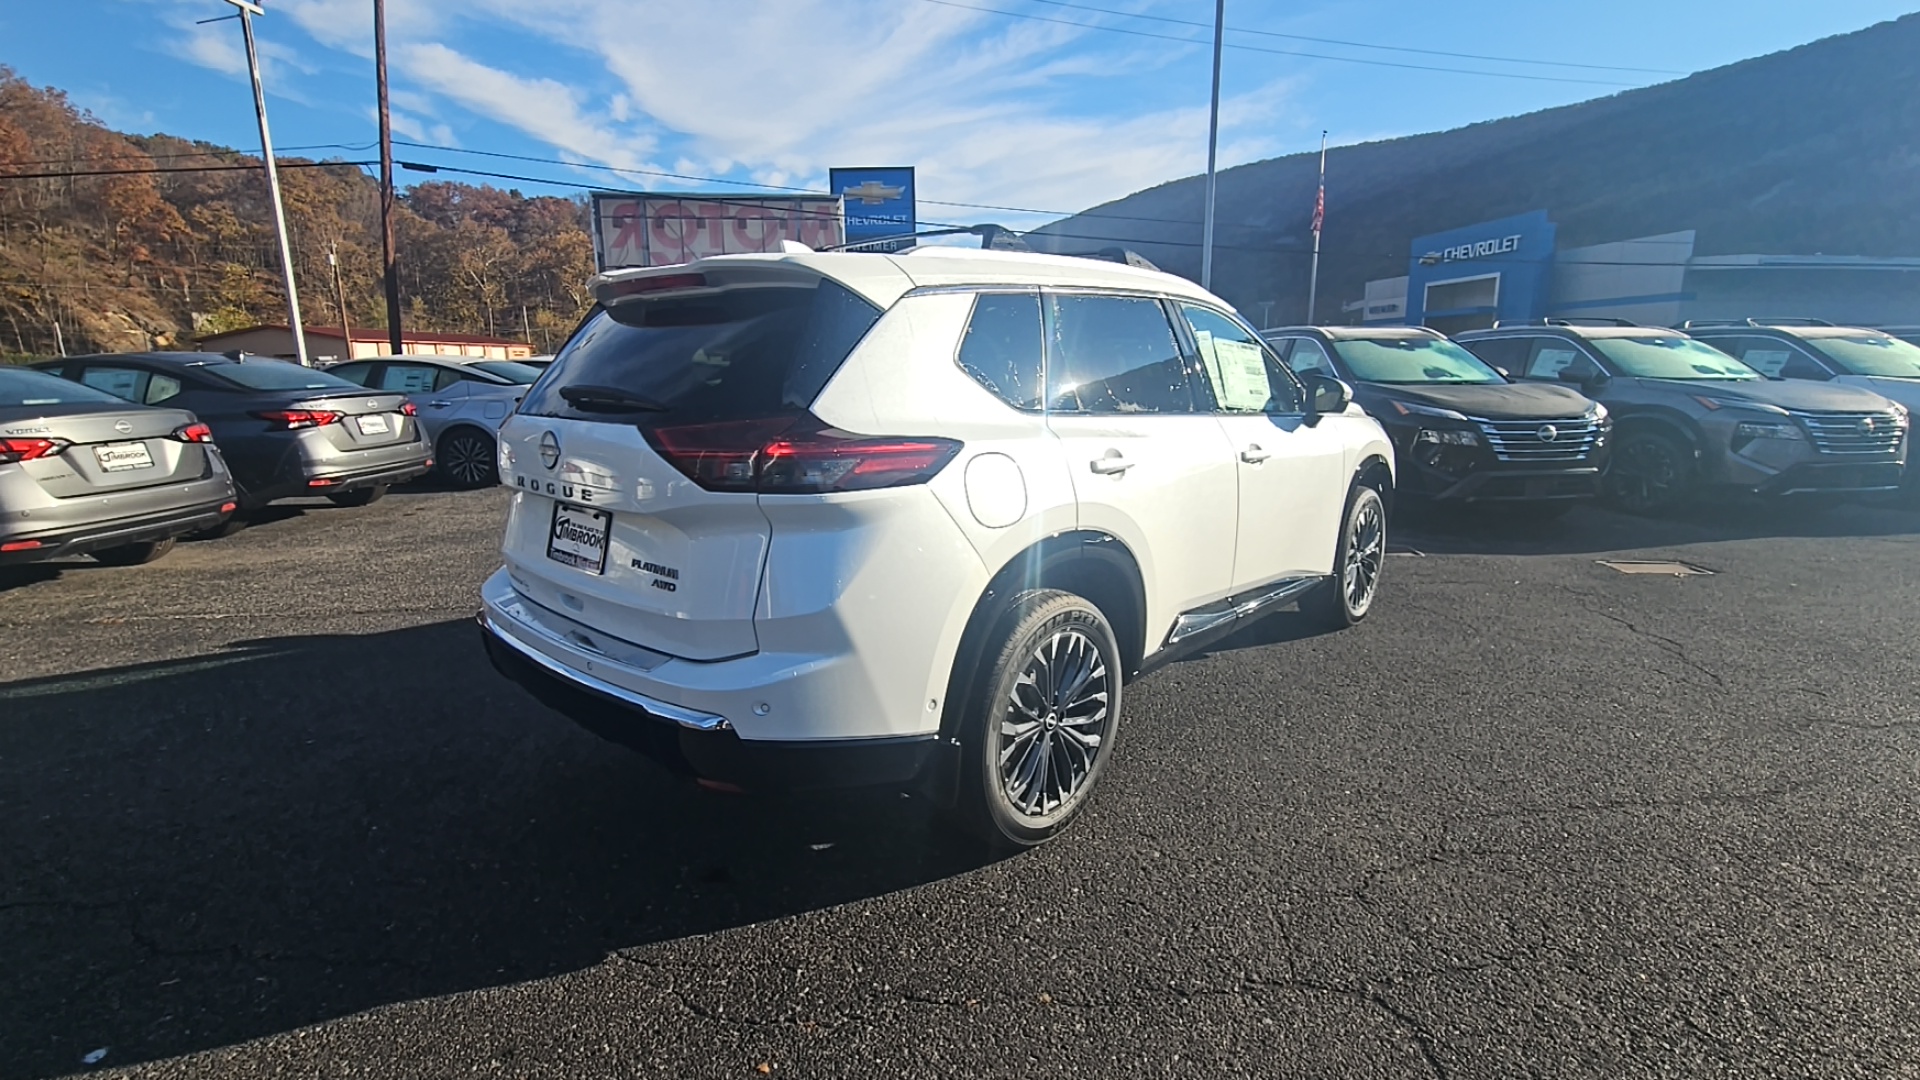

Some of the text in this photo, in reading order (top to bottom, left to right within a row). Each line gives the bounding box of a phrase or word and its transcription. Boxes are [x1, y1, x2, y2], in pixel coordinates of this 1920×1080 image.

[1444, 235, 1521, 262] CHEVROLET
[517, 475, 592, 502] ROGUE
[554, 515, 605, 550] TIMBROOK
[631, 558, 679, 580] PLATINUM
[651, 578, 676, 592] AWD
